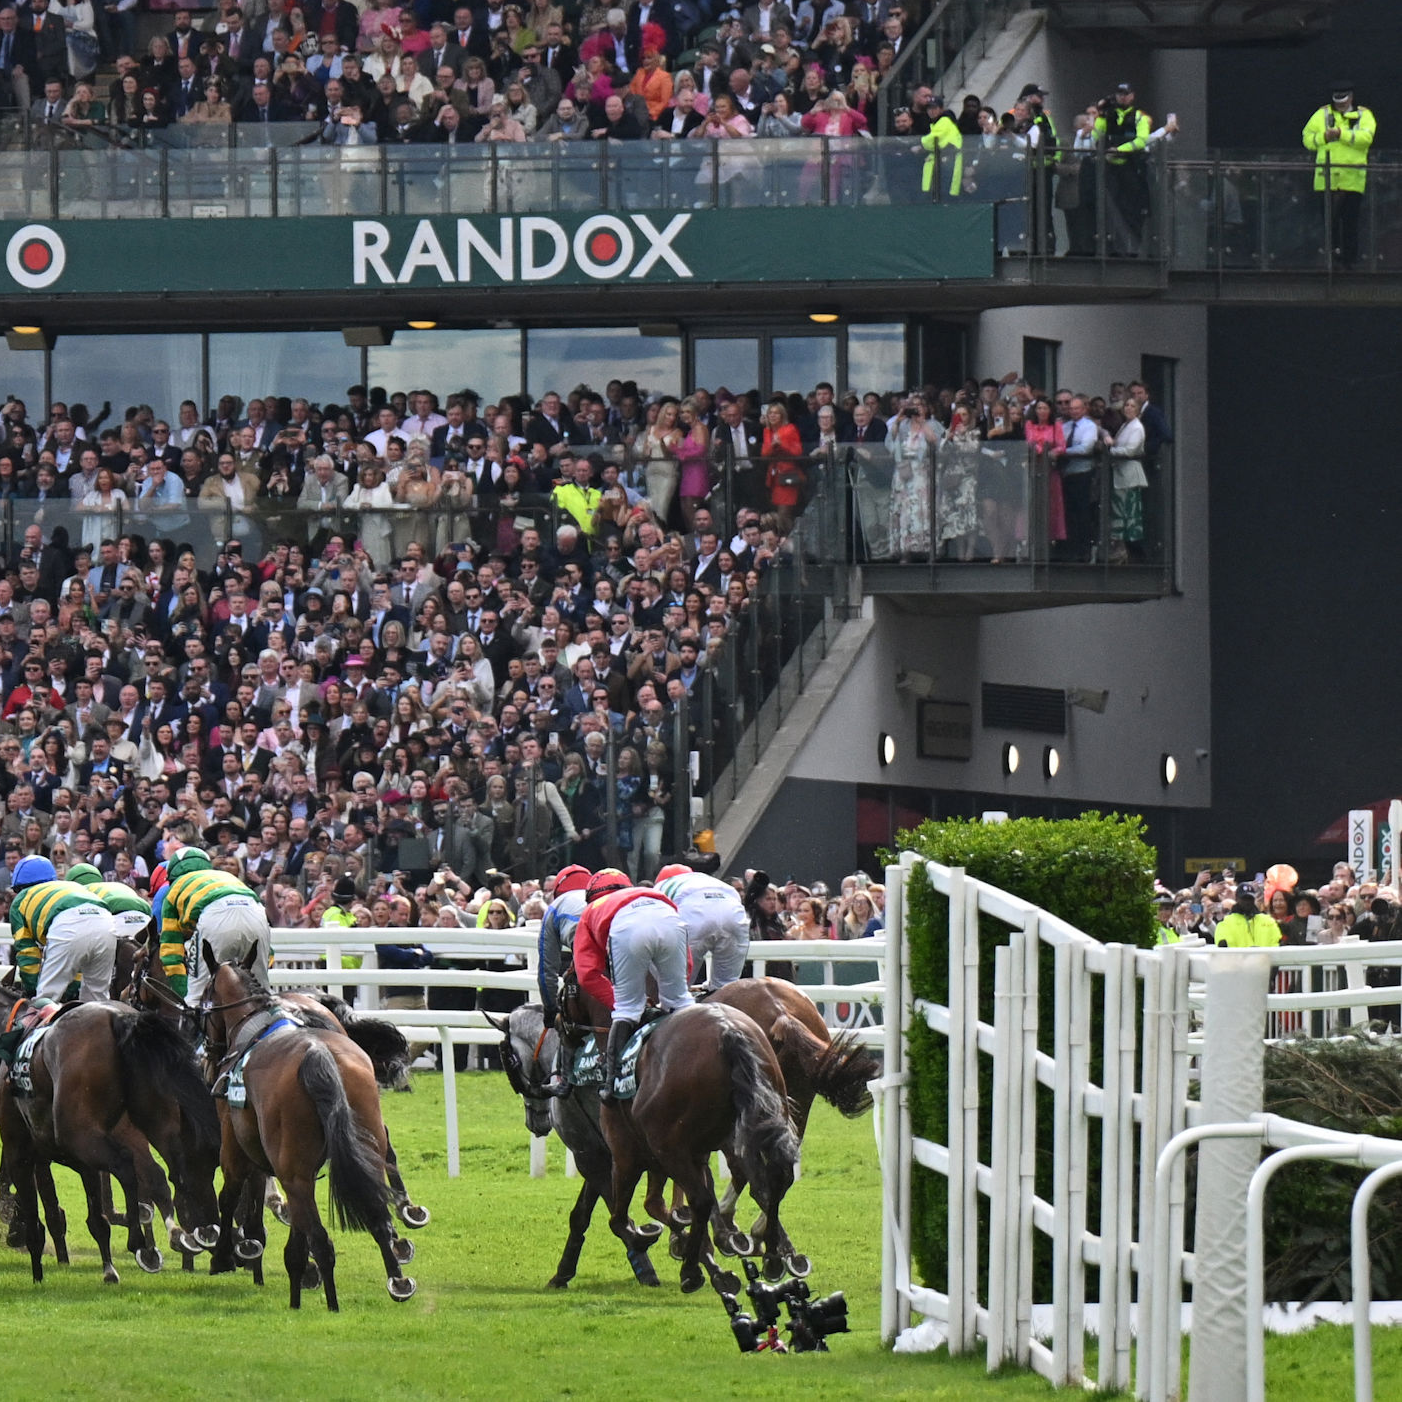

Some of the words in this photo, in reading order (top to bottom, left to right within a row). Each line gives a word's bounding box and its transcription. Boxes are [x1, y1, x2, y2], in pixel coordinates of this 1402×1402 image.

[353, 214, 693, 284] RANDOX
[1353, 818, 1365, 886] ANDOX
[567, 985, 577, 994] 23
